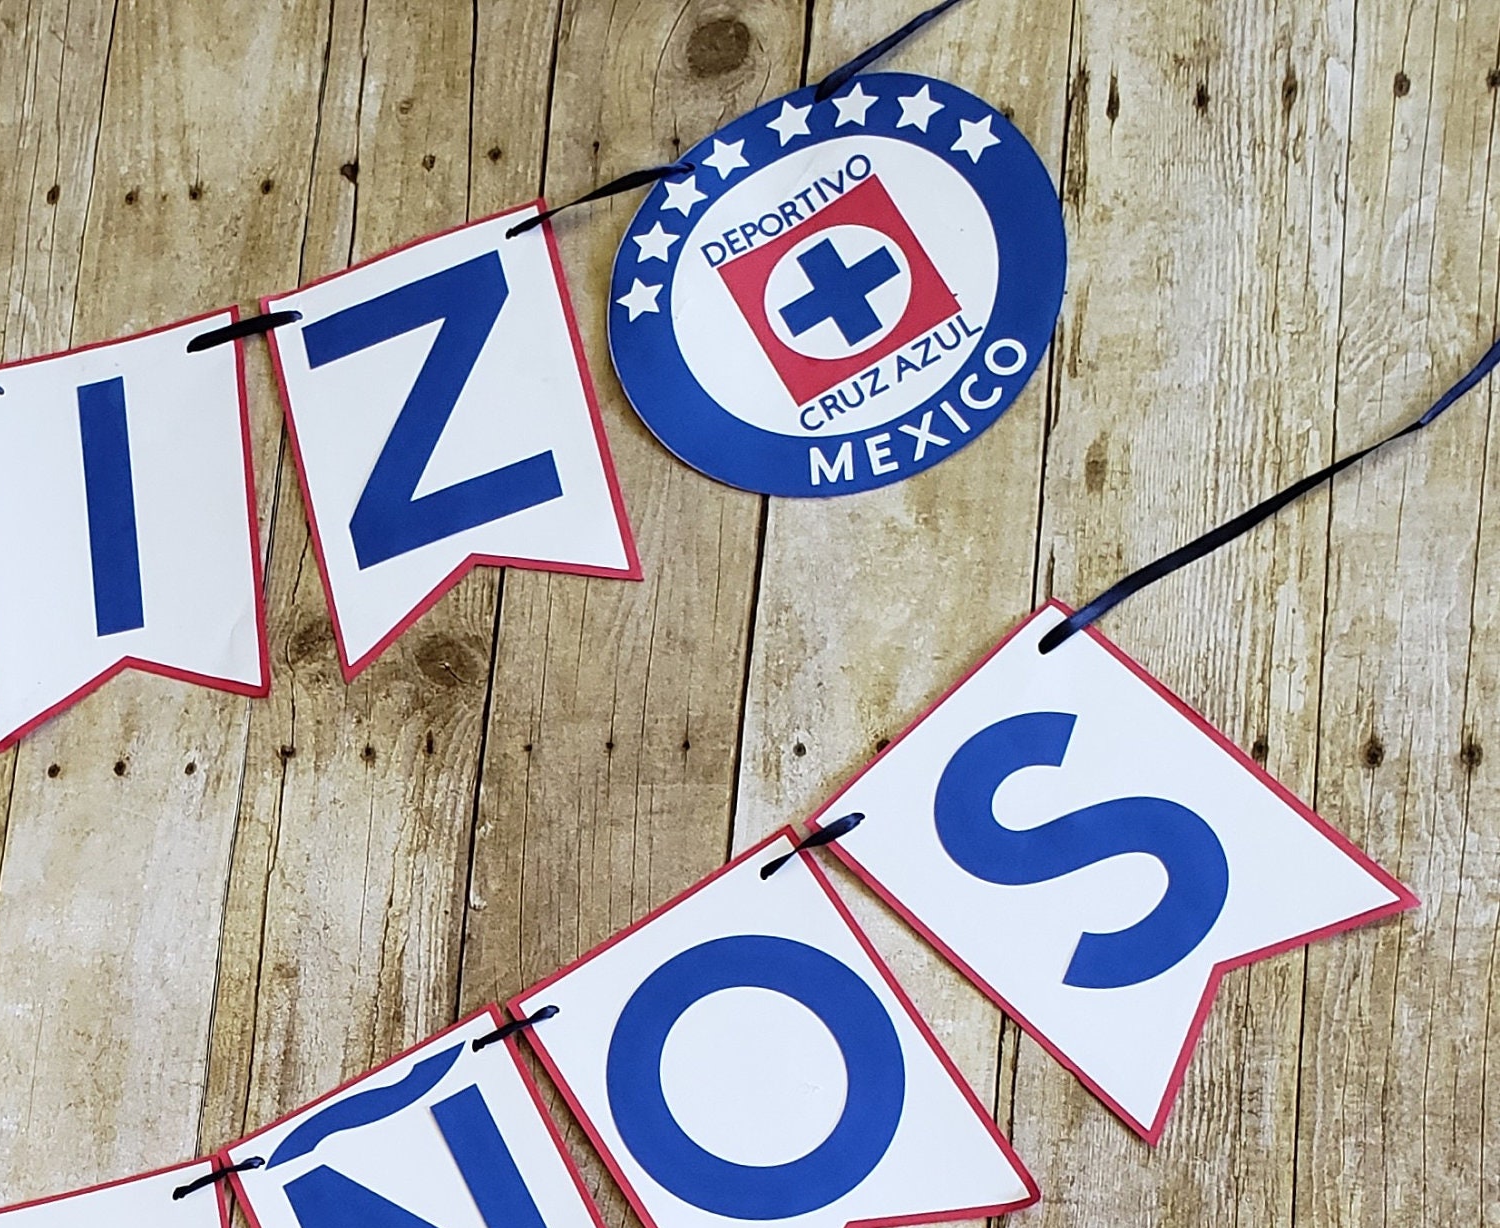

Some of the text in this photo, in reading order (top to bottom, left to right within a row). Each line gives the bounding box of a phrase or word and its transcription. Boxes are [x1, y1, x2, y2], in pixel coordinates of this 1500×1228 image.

[700, 154, 871, 268] DEPORTIVO
[799, 315, 983, 431] CRUZ AZUL
[808, 338, 1027, 486] MEXICO
